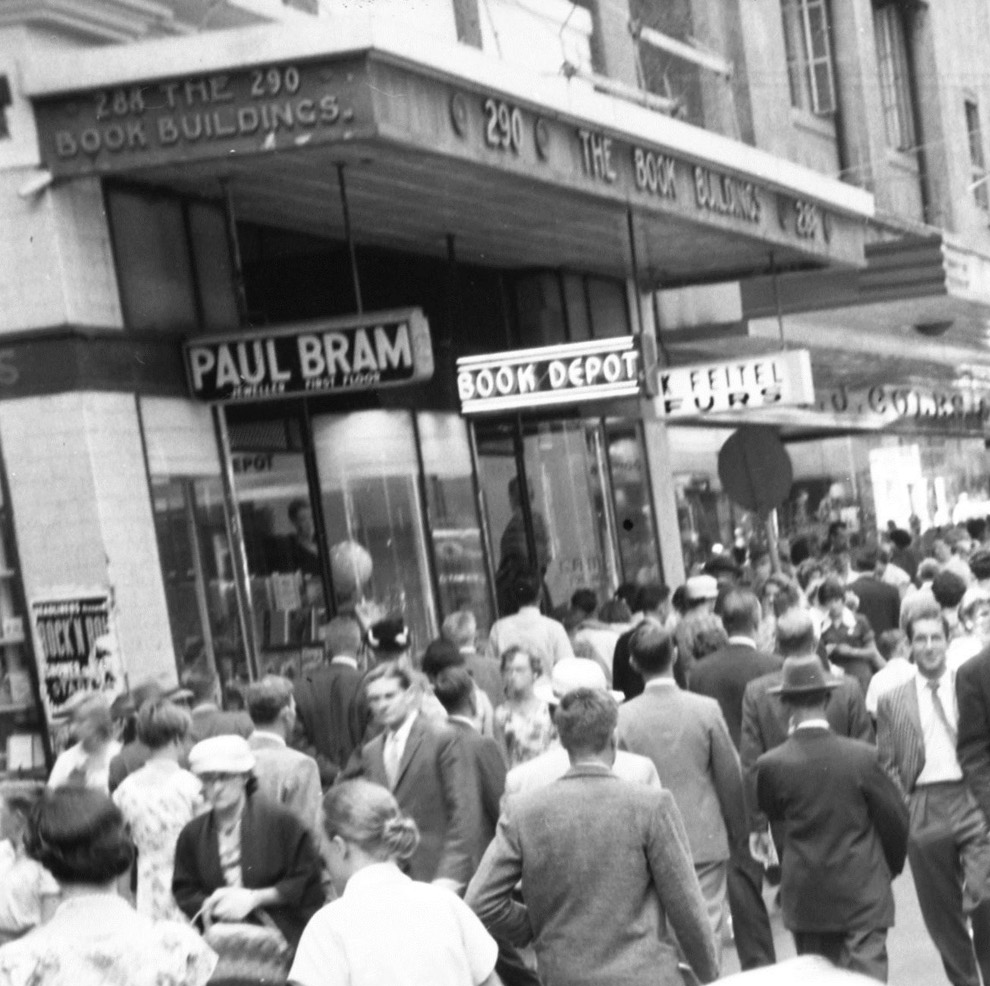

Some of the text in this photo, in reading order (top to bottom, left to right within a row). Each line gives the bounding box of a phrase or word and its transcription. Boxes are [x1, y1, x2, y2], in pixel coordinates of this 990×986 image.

[164, 77, 233, 107] THE
[250, 66, 301, 97] 290
[55, 122, 147, 157] BOOK
[485, 98, 523, 150] 290
[579, 129, 617, 182] THE
[633, 148, 677, 199] BOOK
[190, 322, 413, 391] PAUL BRAM
[457, 350, 639, 400] BOOK DEPOT
[232, 372, 381, 398] JEWELLER FIRST FLOOR
[690, 362, 783, 392] FEITEL
[232, 454, 274, 473] EPOT
